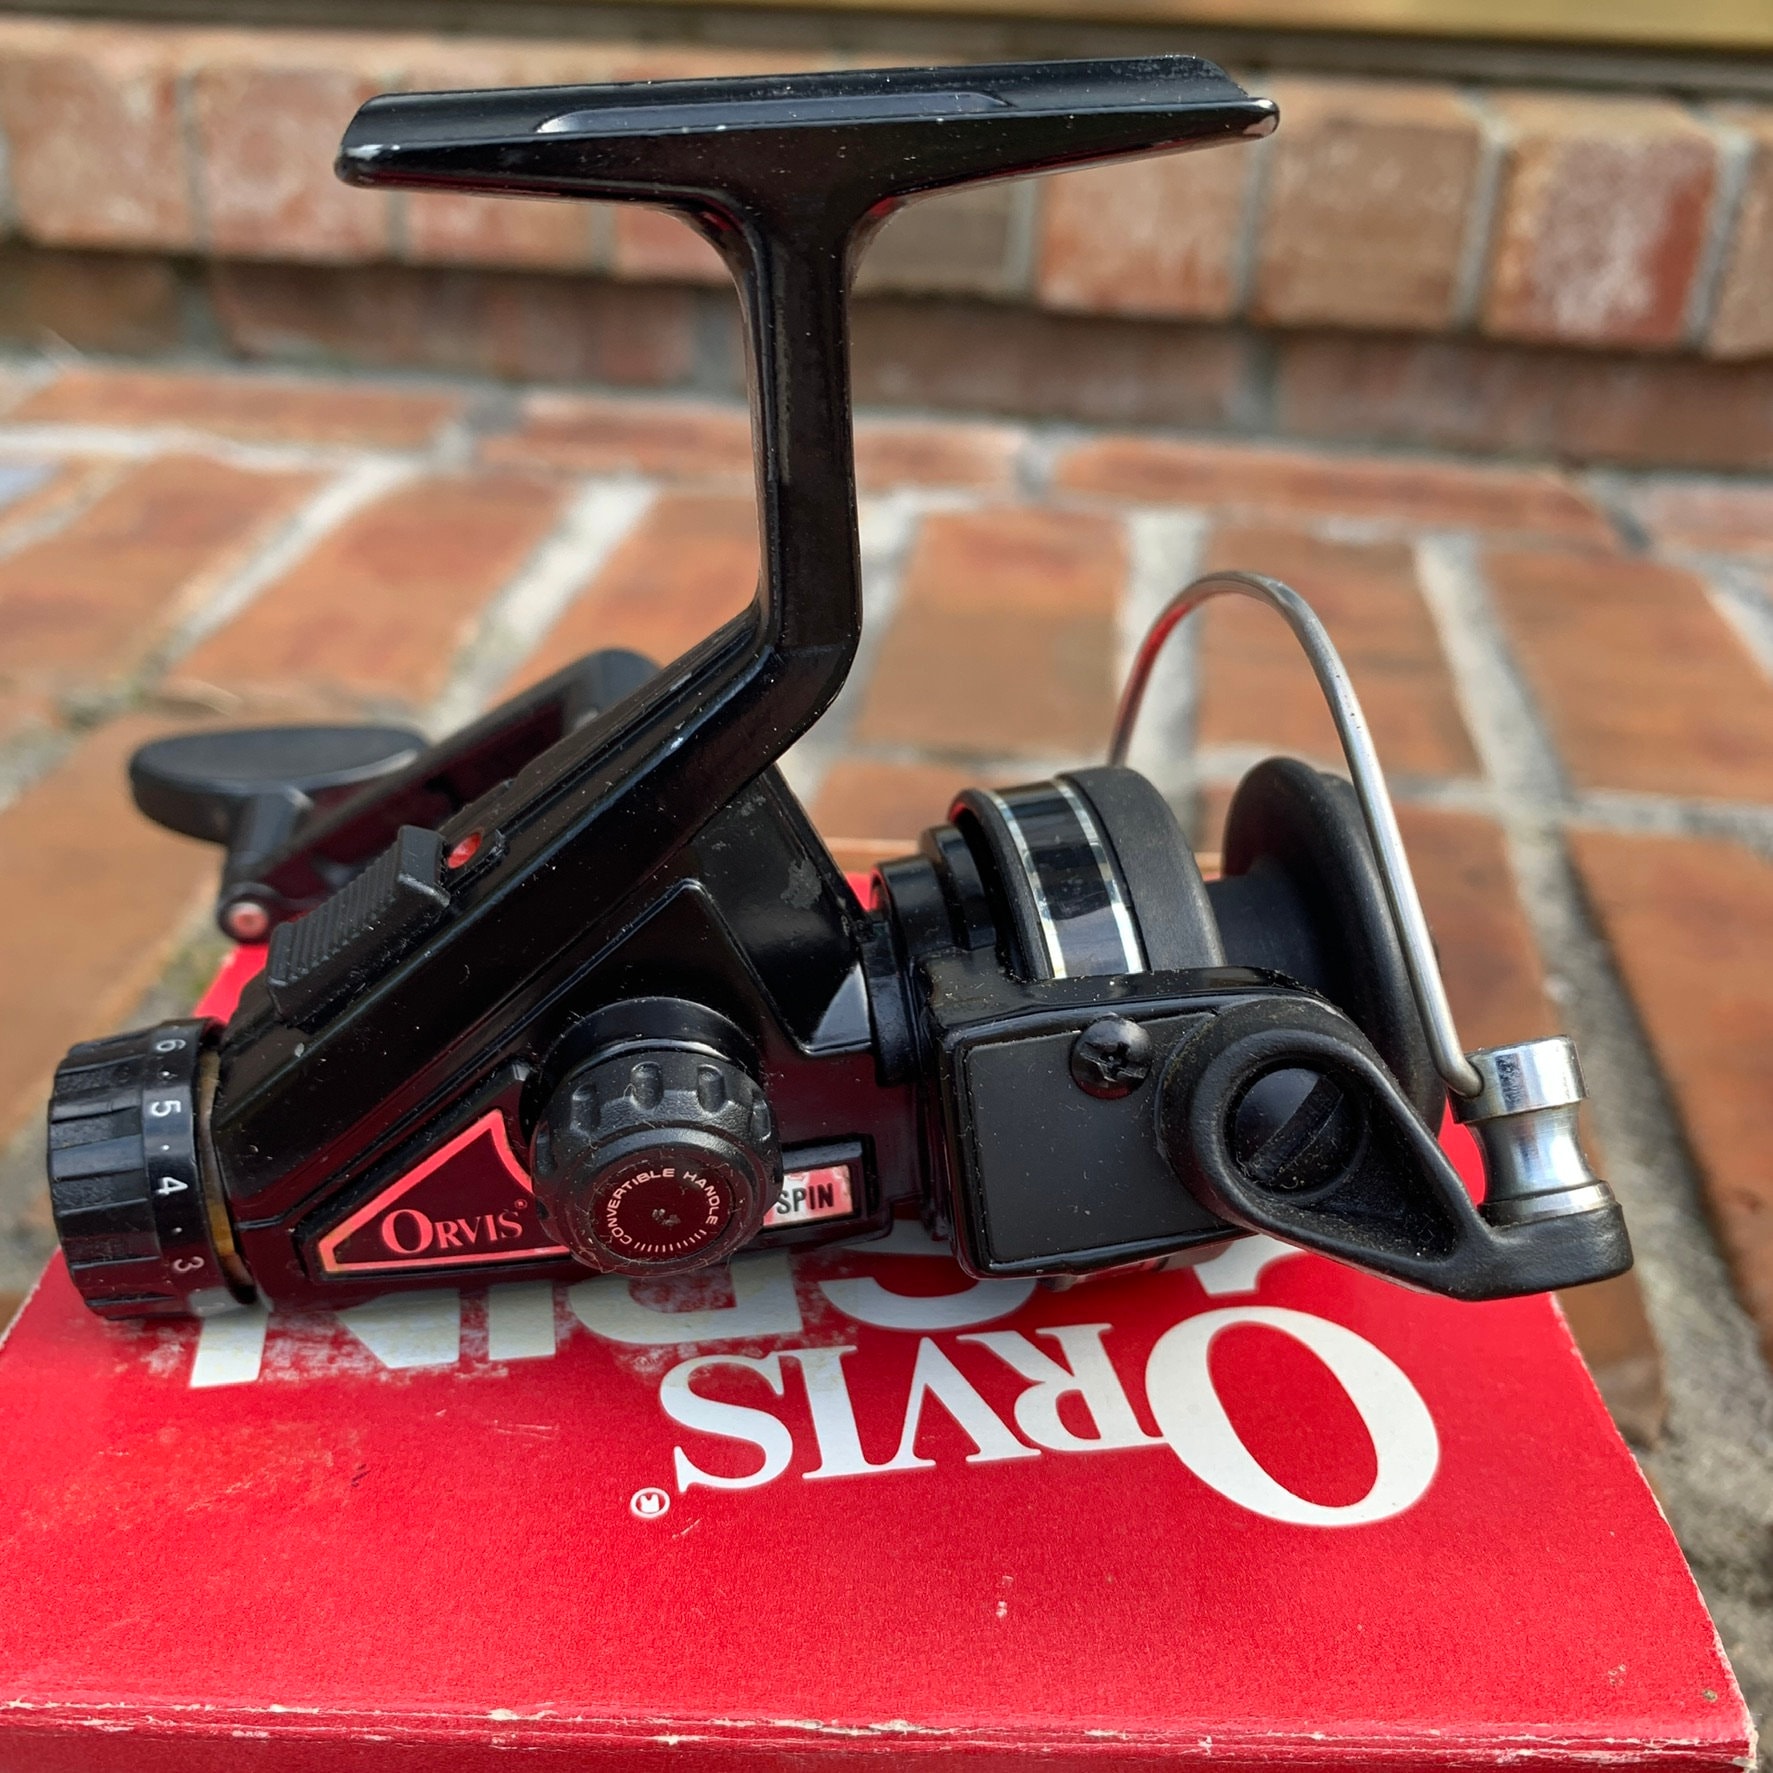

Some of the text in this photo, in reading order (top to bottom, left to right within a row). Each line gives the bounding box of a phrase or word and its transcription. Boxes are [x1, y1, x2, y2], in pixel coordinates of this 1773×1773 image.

[151, 1038, 205, 1274] 6 5 4 3
[606, 1167, 721, 1245] CONVERTIBLE HANDLE
[776, 1182, 835, 1215] SPIN
